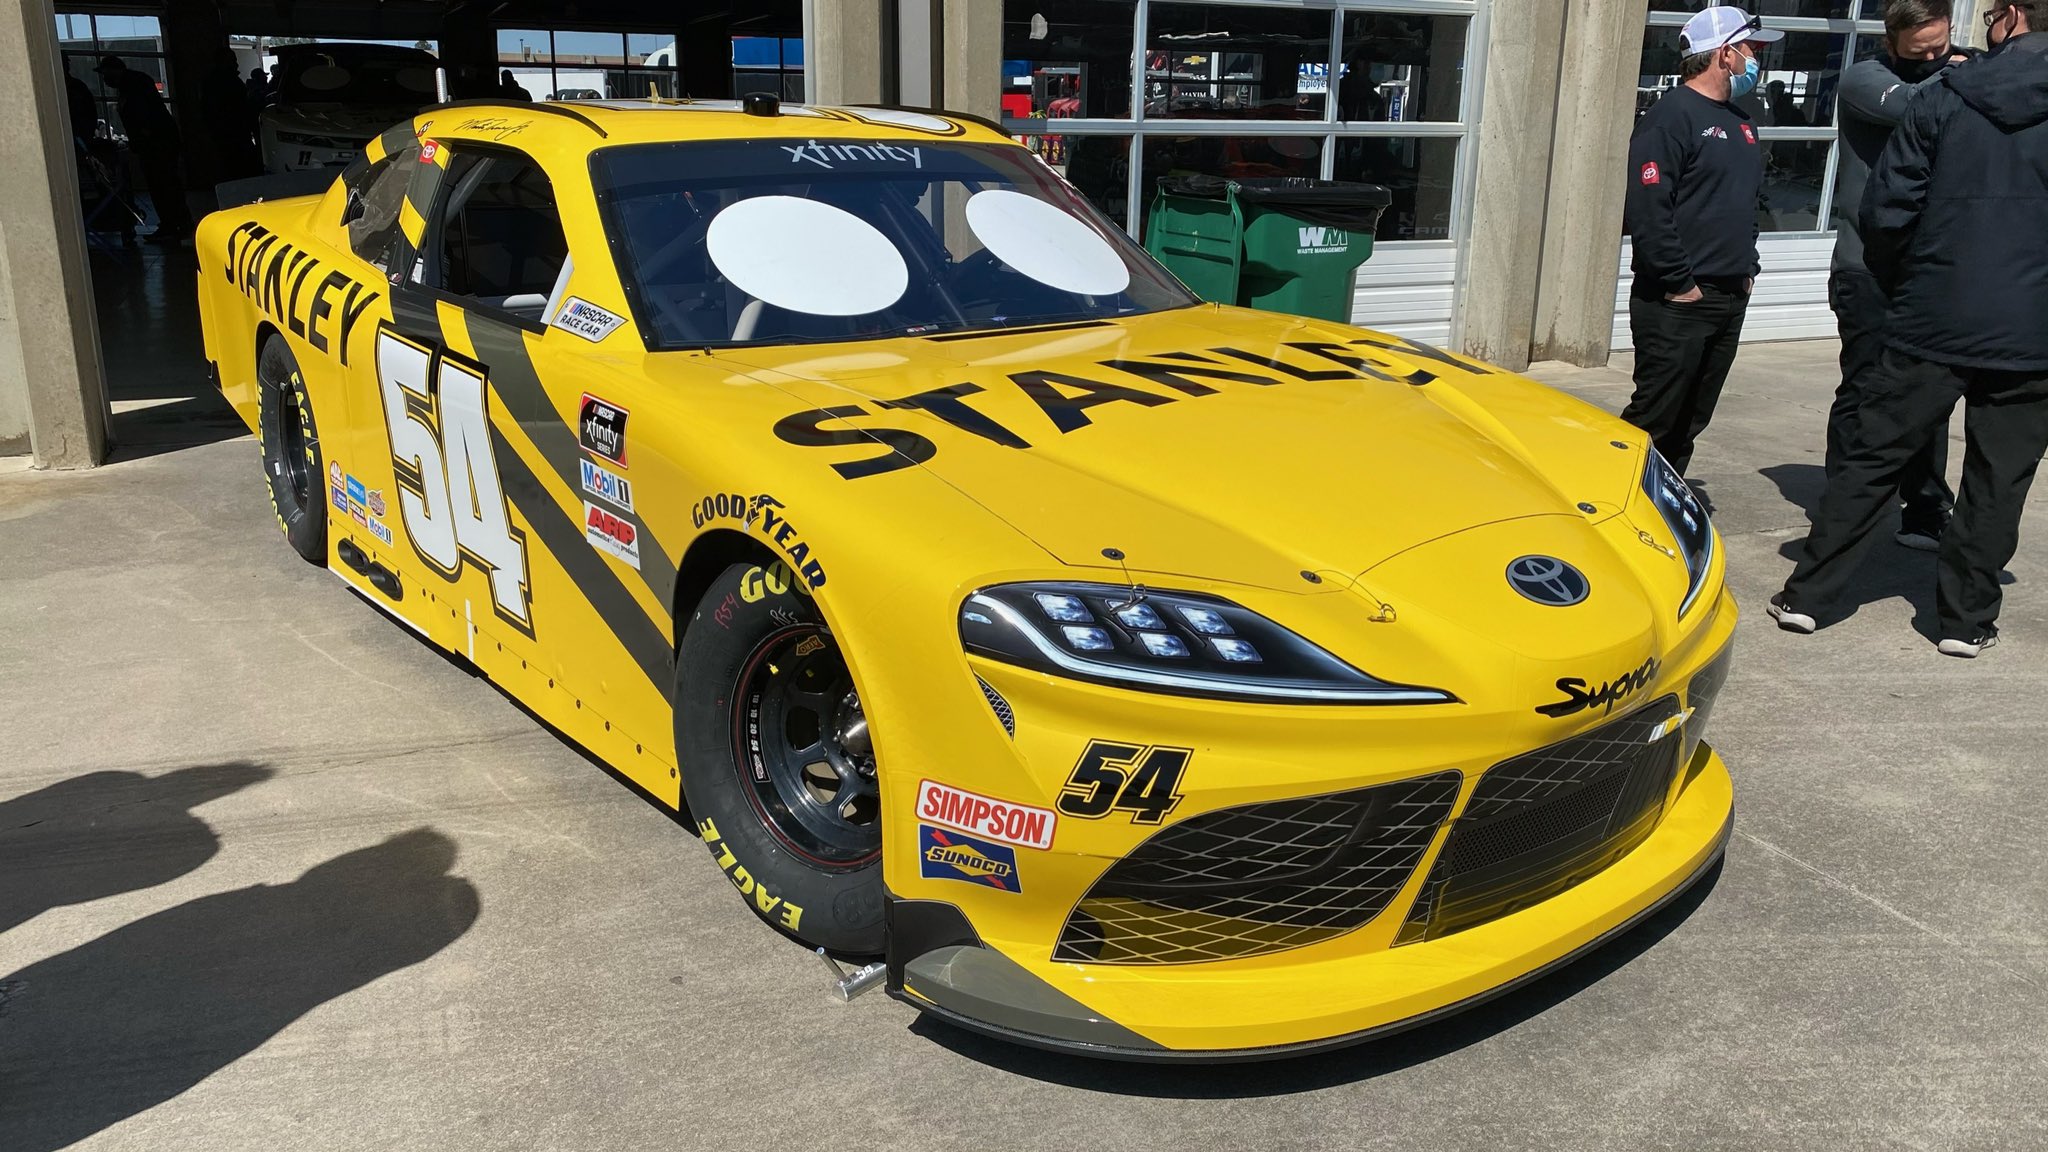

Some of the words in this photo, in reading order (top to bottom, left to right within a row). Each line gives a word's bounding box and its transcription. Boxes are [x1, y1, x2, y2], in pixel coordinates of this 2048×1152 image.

[780, 139, 922, 169] xfinity
[1298, 227, 1348, 247] WM
[1314, 246, 1348, 254] MANAGEMENT
[225, 221, 380, 367] STANLEY
[560, 314, 579, 329] RACE
[581, 322, 600, 336] CAR
[573, 303, 613, 327] NASCAR
[291, 371, 315, 466] EAGLE
[596, 404, 615, 421] NASCAR
[773, 339, 1495, 480] STANLEY
[586, 416, 618, 452] xfinity
[597, 441, 611, 455] SERIES
[376, 320, 535, 640] 54
[583, 462, 617, 498] Mobil
[369, 517, 385, 538] Mobil
[587, 506, 636, 546] ARP
[1535, 656, 1661, 718] Supra
[1055, 738, 1195, 825] 54
[923, 787, 1047, 844] SIMPSON
[696, 817, 803, 931] EAGLE
[930, 847, 1010, 876] SUNOCO
